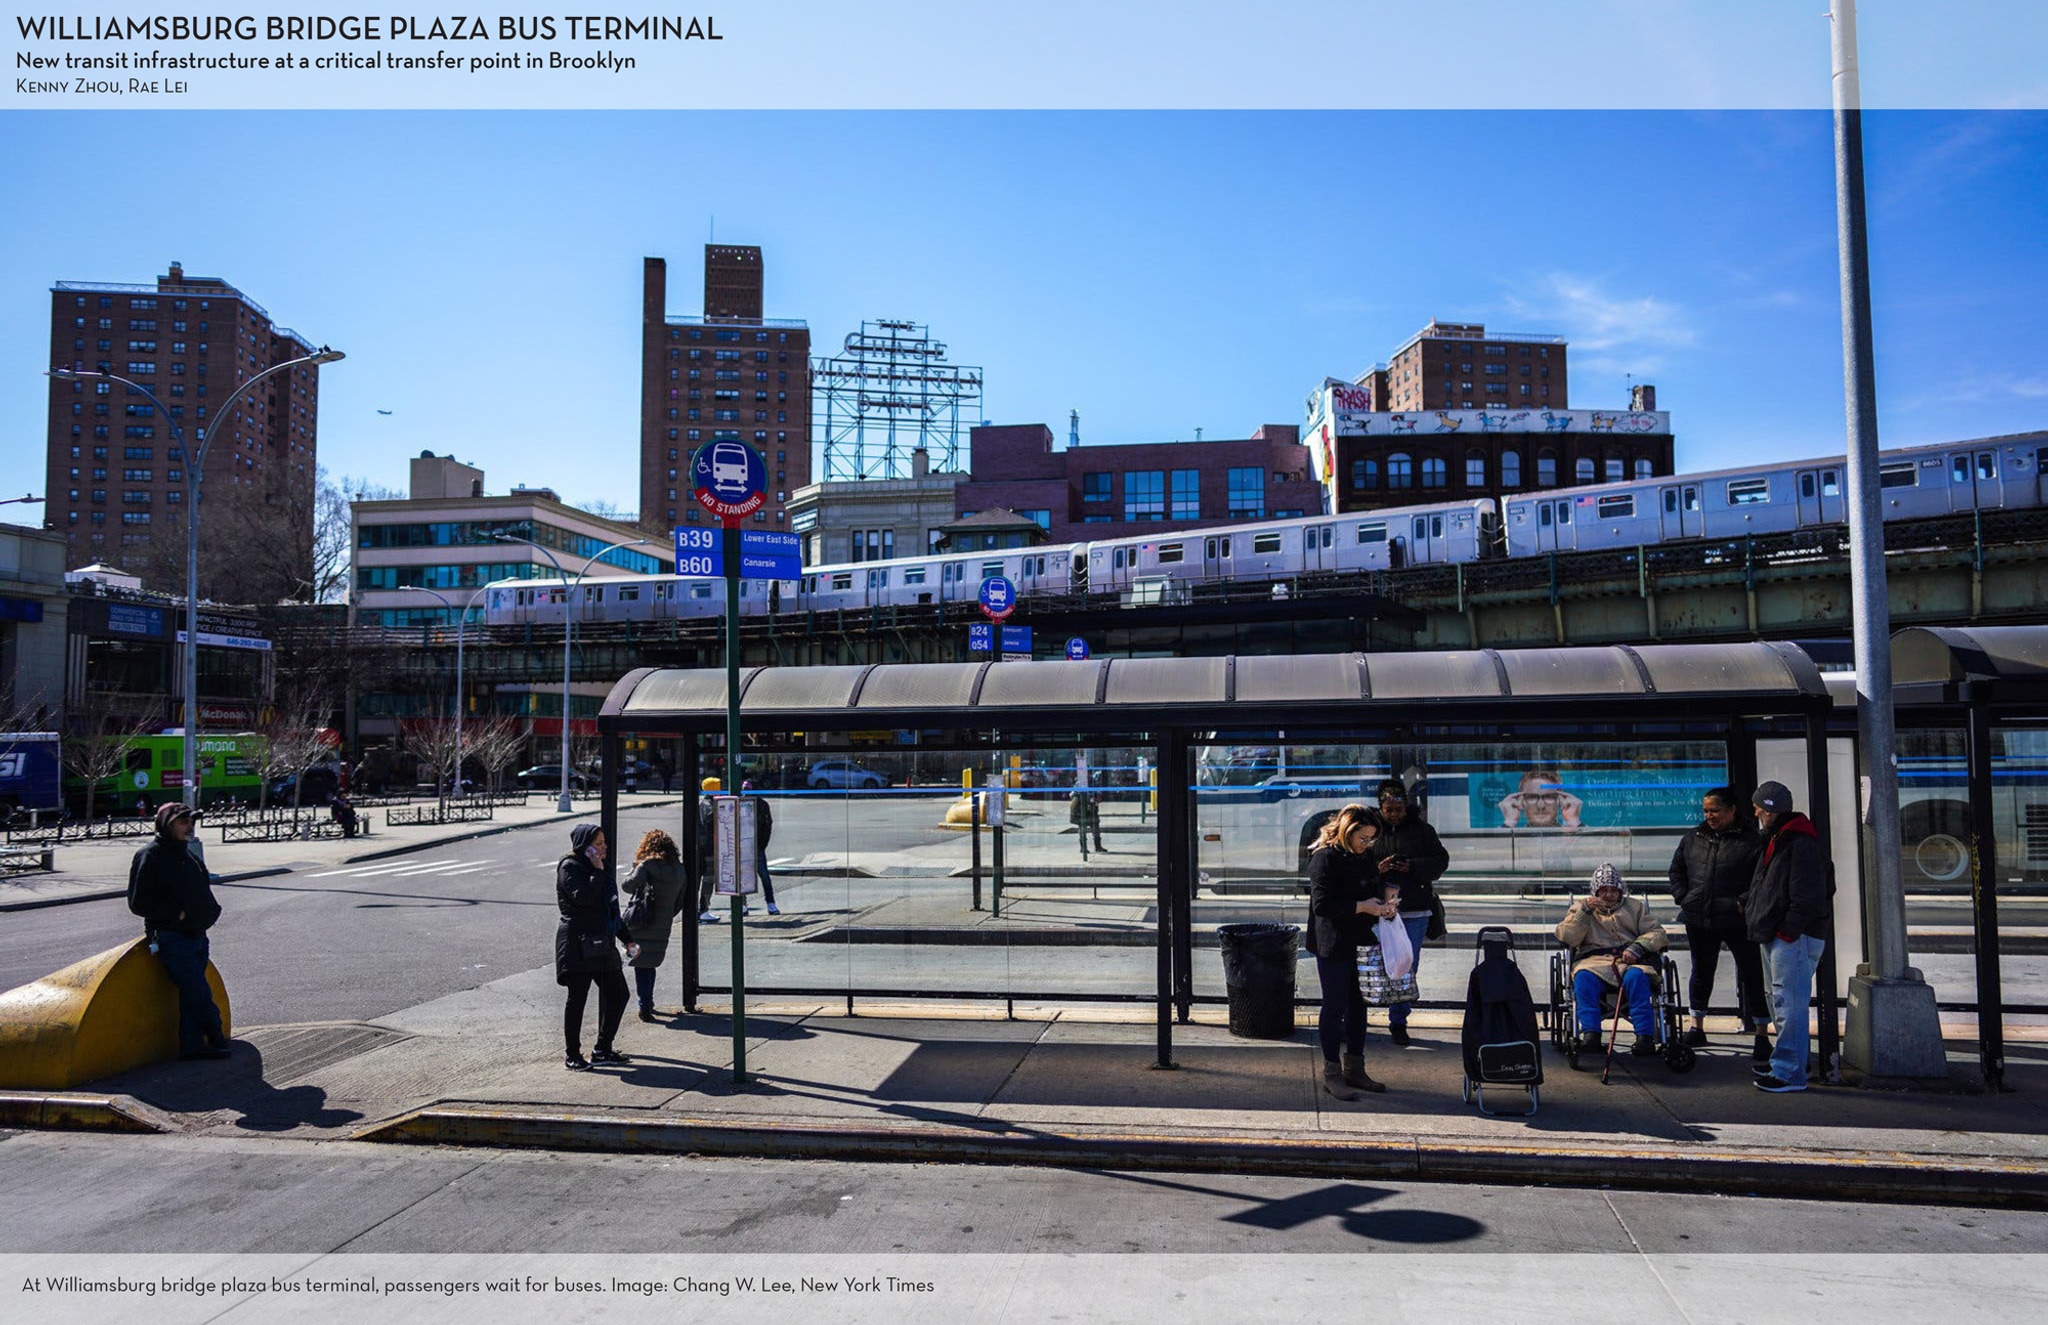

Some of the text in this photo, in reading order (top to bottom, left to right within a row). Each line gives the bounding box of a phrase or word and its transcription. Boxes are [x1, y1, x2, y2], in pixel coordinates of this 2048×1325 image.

[876, 319, 916, 332] THE
[844, 332, 948, 362] CHASE
[808, 357, 983, 390] MANHATTAN
[858, 394, 936, 415] BANK
[701, 493, 761, 515] NO STANDING
[679, 530, 714, 549] B39
[743, 533, 798, 546] Lower East Side
[679, 556, 713, 574] B60
[743, 558, 777, 568] Canarsie
[971, 626, 988, 635] B24
[971, 640, 988, 650] Q54
[200, 710, 255, 721] McDonal
[195, 741, 237, 752] umana
